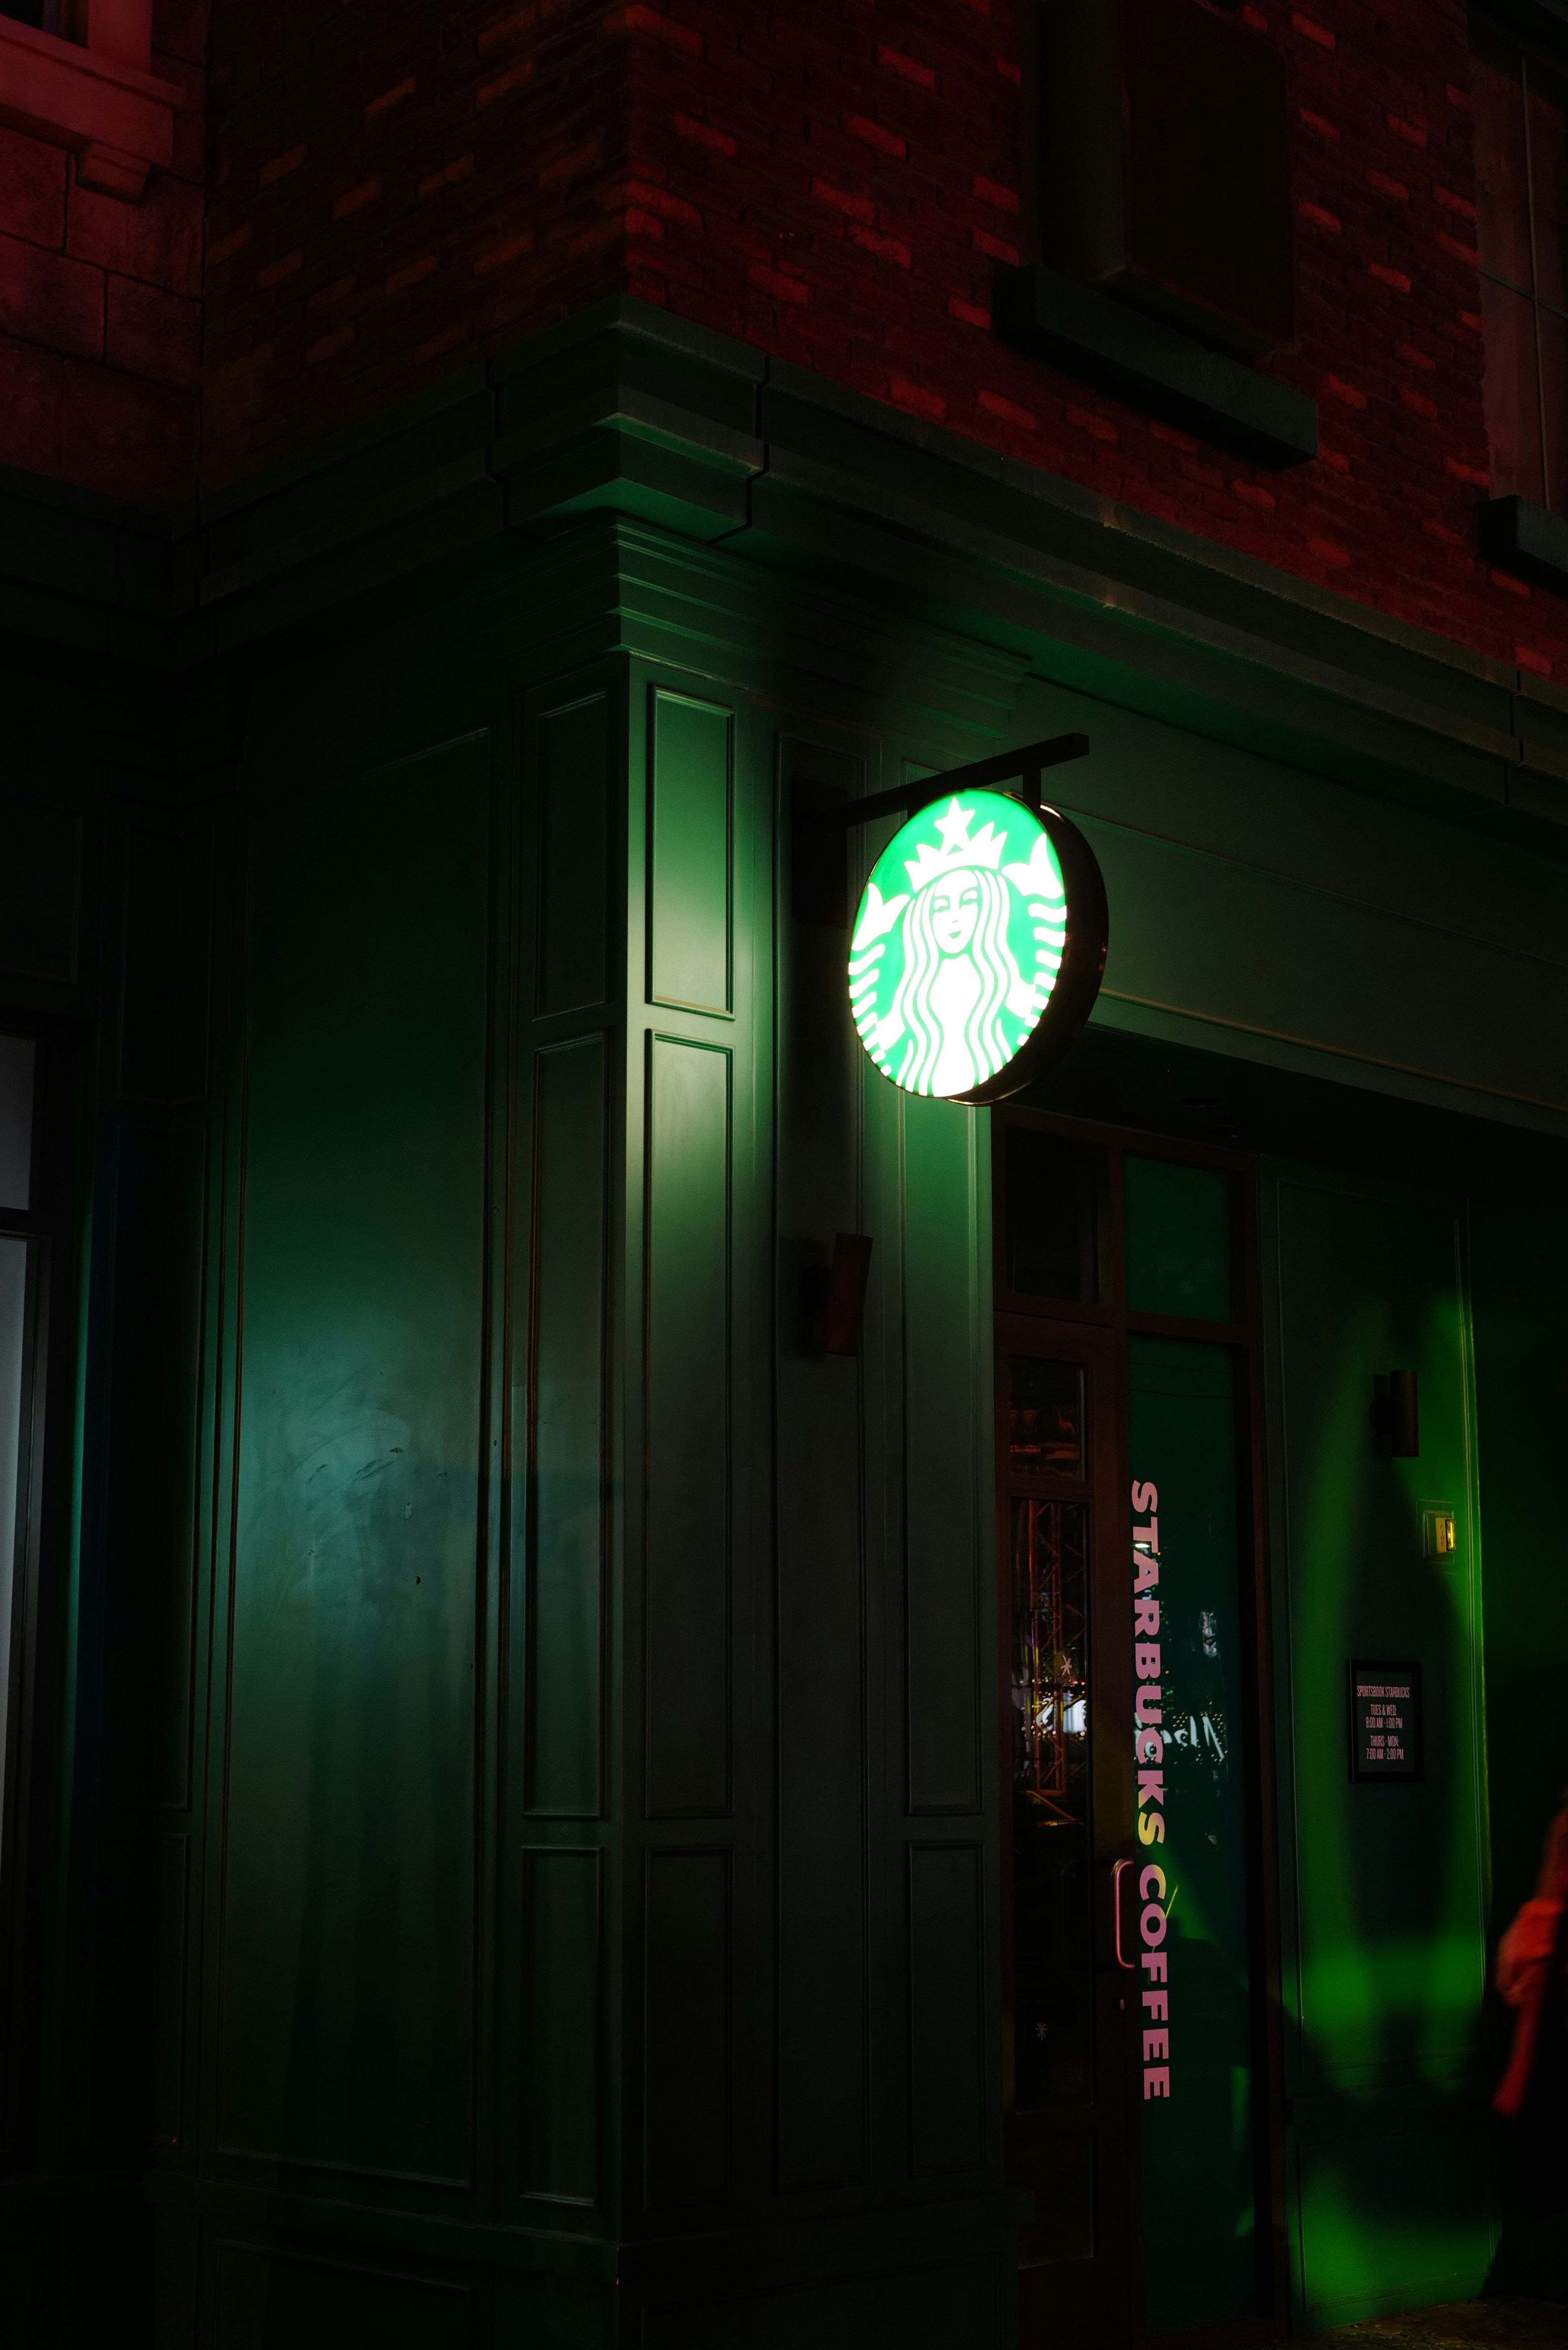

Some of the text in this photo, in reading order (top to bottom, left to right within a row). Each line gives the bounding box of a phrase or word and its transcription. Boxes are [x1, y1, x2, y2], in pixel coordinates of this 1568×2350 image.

[1356, 1685, 1410, 1698] SPORTSBOOK STARBUCKS
[1370, 1704, 1397, 1716] TUES & WED:
[1365, 1716, 1376, 1728] 8:00
[1376, 1717, 1383, 1728] AM
[1386, 1717, 1395, 1728] 1:00
[1396, 1717, 1403, 1729] PM
[1370, 1735, 1385, 1746] THURS
[1388, 1735, 1399, 1747] MON:
[1366, 1748, 1376, 1759] 7:00
[1377, 1748, 1384, 1759] AM
[1387, 1748, 1396, 1760] 2:00
[1397, 1748, 1404, 1760] PM
[1131, 1480, 1170, 2100] STARBUCKS COFFEE
